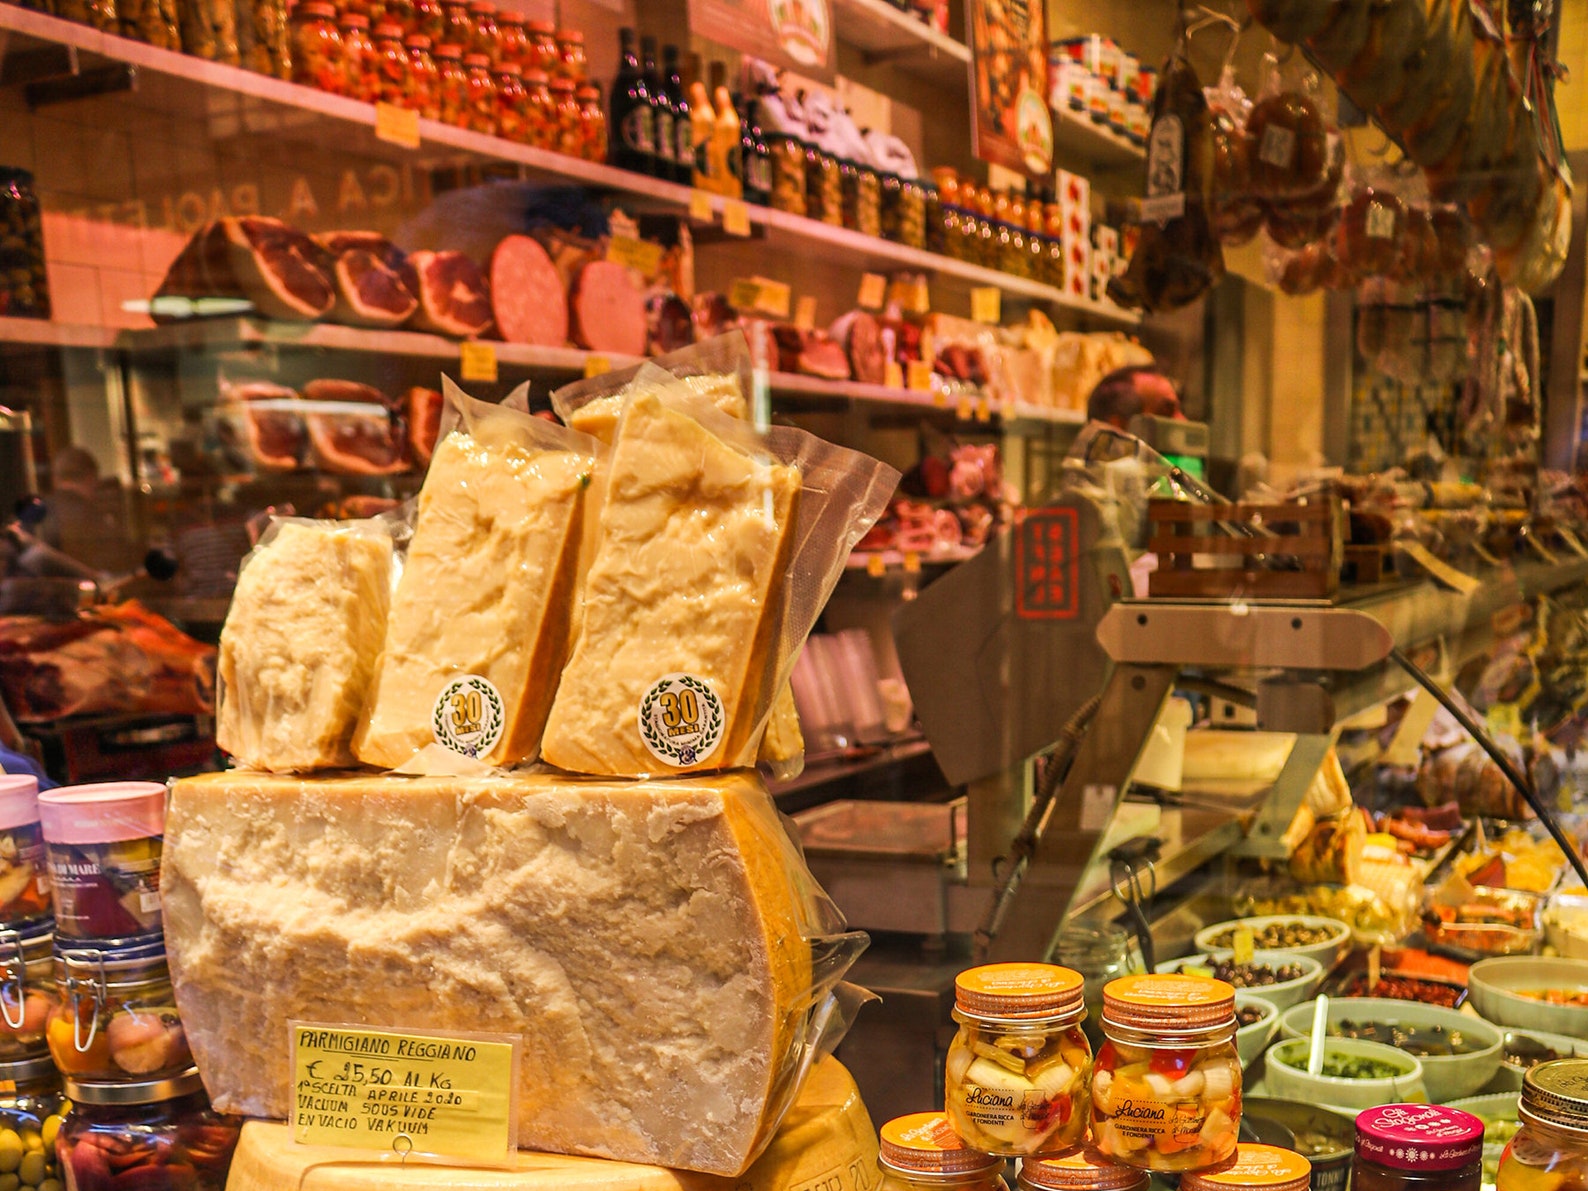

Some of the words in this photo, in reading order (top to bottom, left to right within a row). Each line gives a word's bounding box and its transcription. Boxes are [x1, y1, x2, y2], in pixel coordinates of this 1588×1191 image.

[451, 690, 482, 727] 30
[660, 689, 699, 727] 30
[667, 724, 700, 737] MESI
[300, 1031, 390, 1054] PARMIGIANO
[397, 1039, 477, 1062] REGGIANO
[306, 1060, 324, 1080] €
[333, 1061, 393, 1086] 25,50
[404, 1071, 421, 1087] AL
[311, 1082, 357, 1097] SCELTA
[367, 1090, 418, 1104] APRILE
[423, 1092, 463, 1106] 2020
[965, 1087, 1014, 1107] Luciana
[298, 1095, 349, 1113] VACUUM
[360, 1103, 399, 1118] SOUS
[403, 1105, 437, 1121] VIDE
[1115, 1099, 1165, 1120] Luciana
[298, 1114, 314, 1127] EN
[319, 1114, 358, 1130] VACIO
[366, 1117, 429, 1135] VAKUUM
